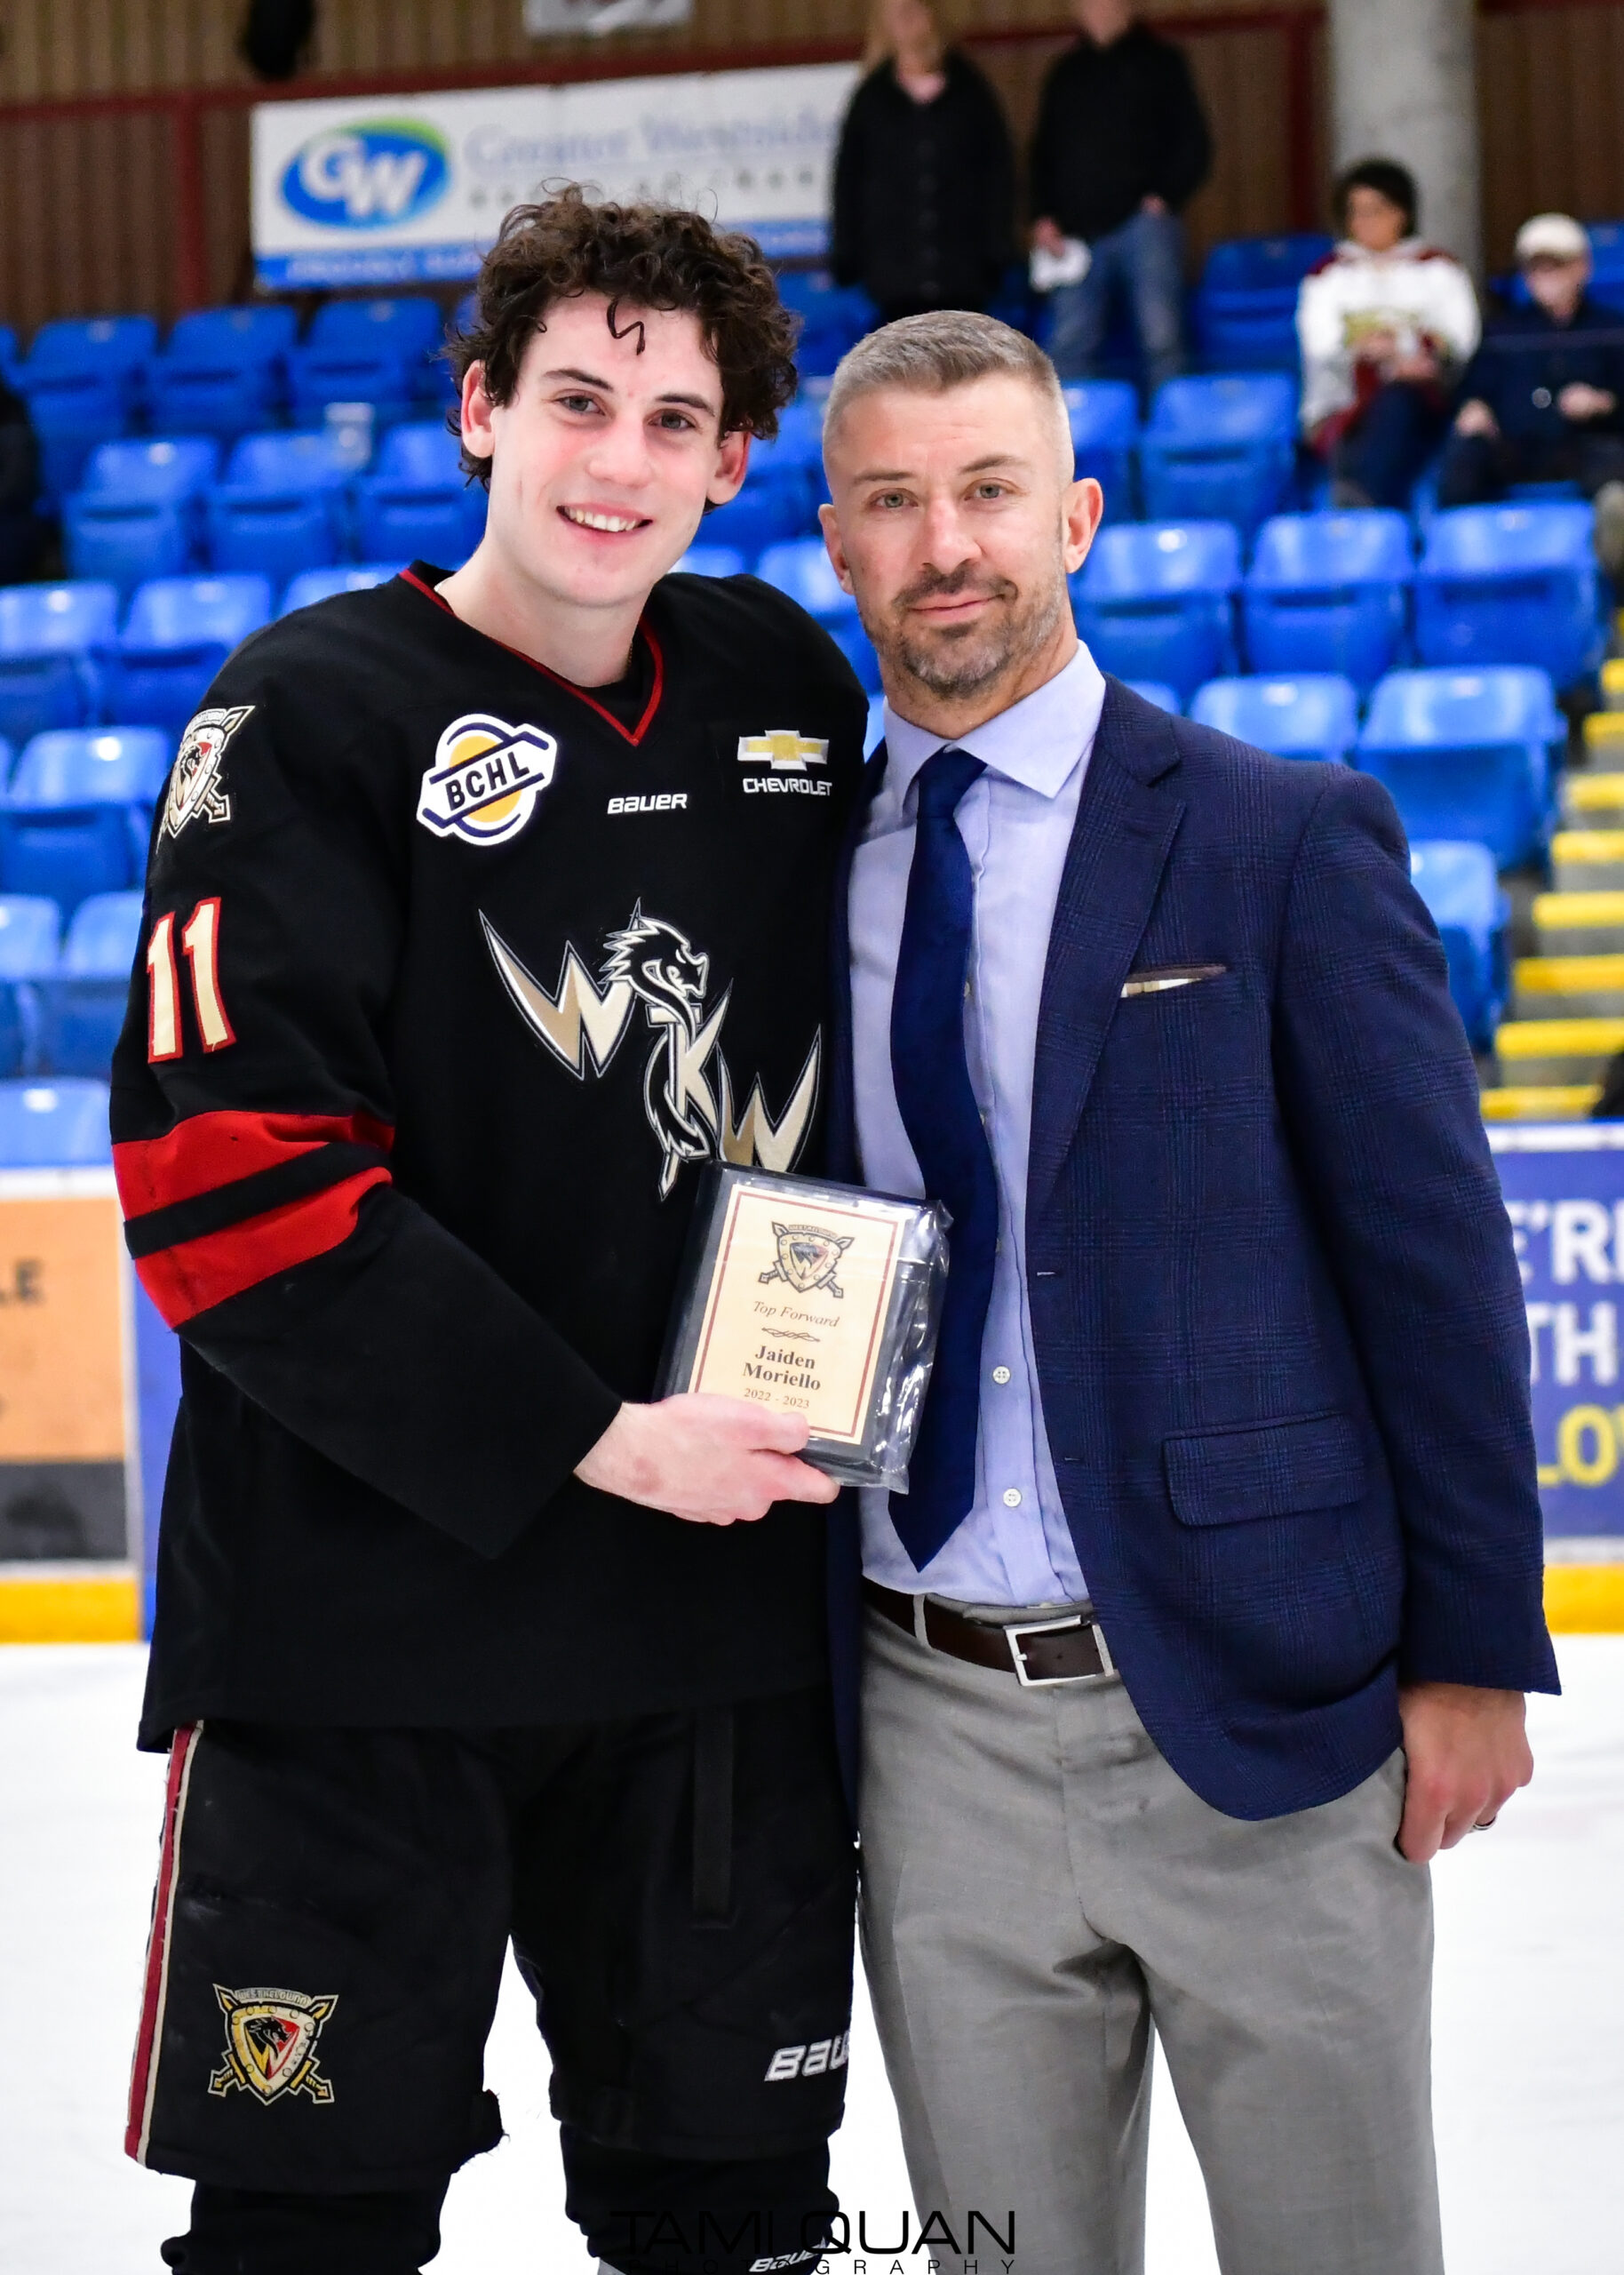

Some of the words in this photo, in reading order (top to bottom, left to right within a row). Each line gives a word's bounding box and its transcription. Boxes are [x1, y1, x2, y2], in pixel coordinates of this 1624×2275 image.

[445, 751, 530, 812] BCHL
[743, 778, 833, 797] CHEVROLET
[147, 897, 237, 1064] 11
[753, 1300, 777, 1318] Top
[780, 1306, 840, 1328] Forward
[755, 1345, 816, 1369] Jaiden
[743, 1362, 822, 1391] Moriello
[744, 1387, 772, 1402] 2022
[782, 1395, 810, 1409] 2023
